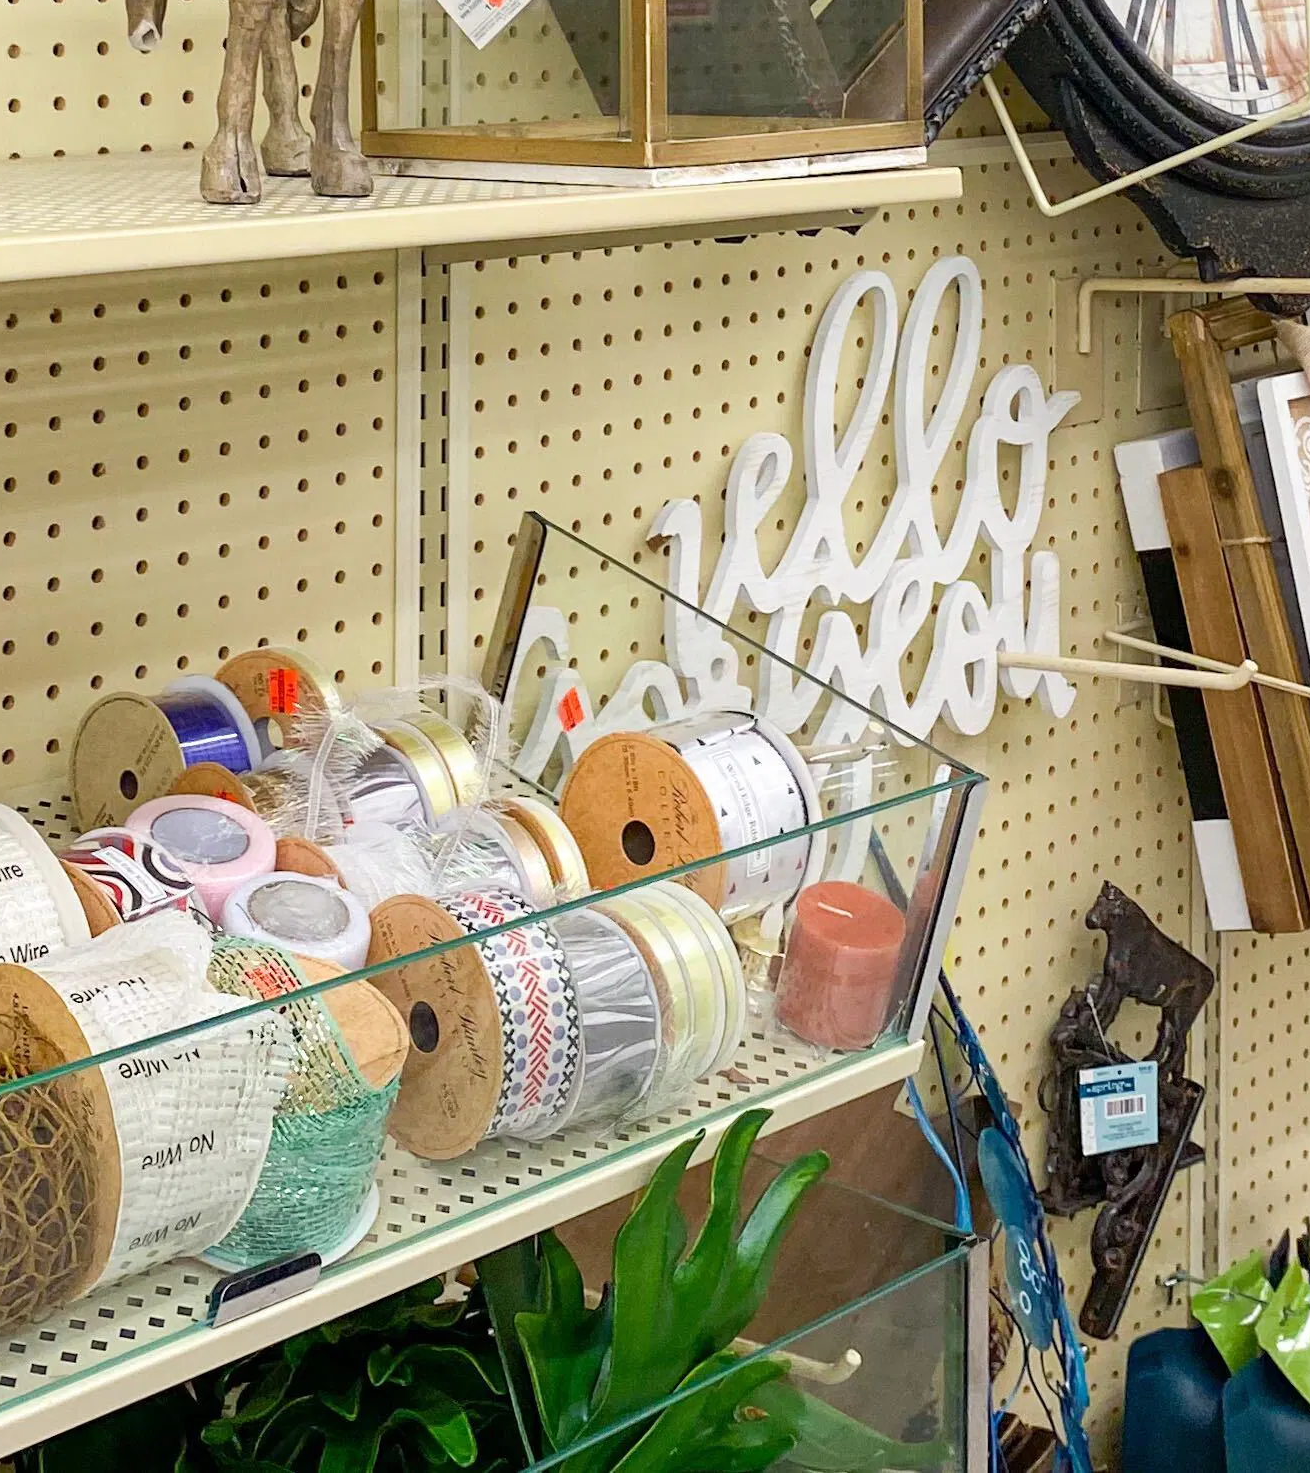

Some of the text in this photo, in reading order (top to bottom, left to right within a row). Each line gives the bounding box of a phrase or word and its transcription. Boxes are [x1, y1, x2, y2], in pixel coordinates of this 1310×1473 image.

[142, 1129, 217, 1171] No Wire
[127, 1211, 203, 1254] No Wire
